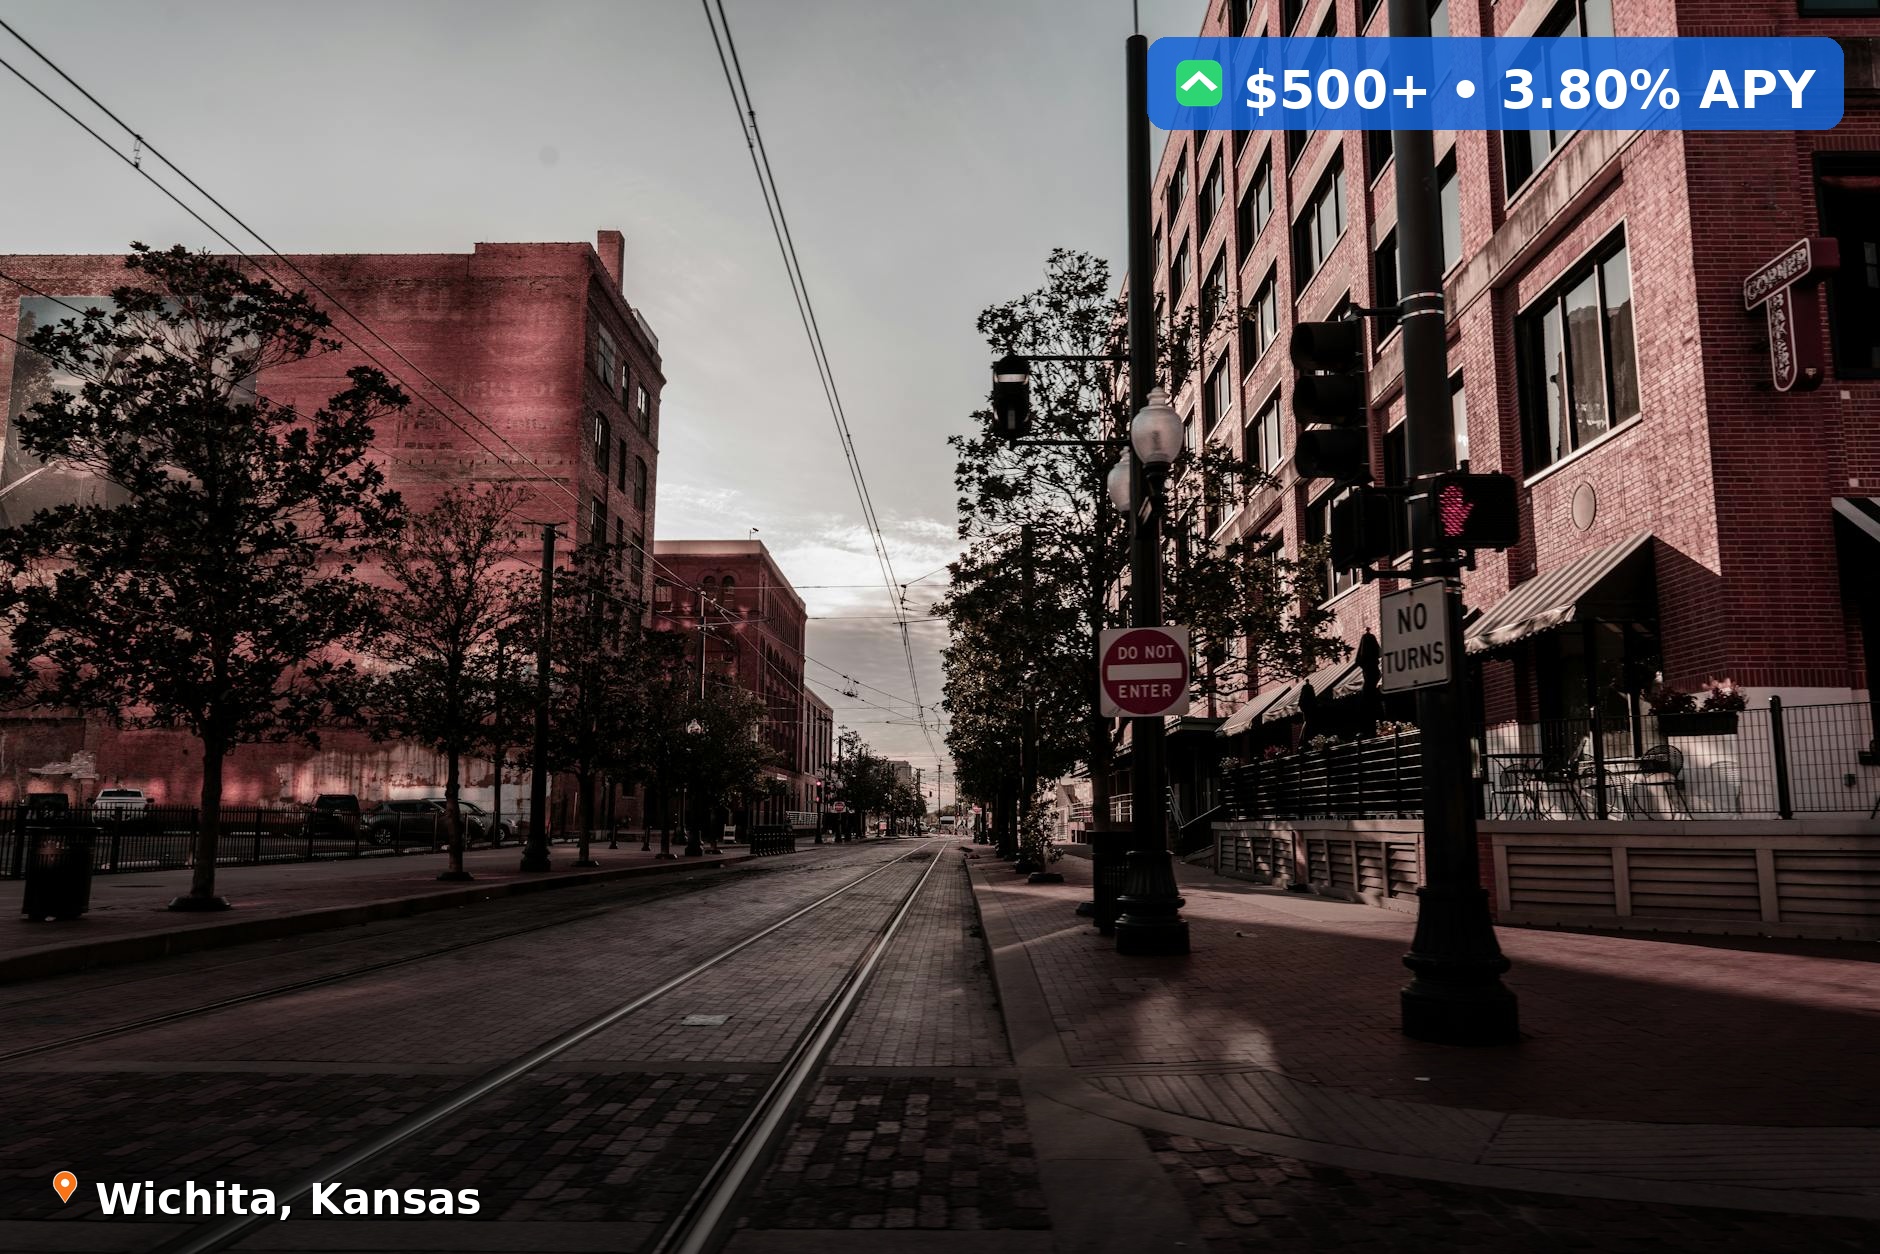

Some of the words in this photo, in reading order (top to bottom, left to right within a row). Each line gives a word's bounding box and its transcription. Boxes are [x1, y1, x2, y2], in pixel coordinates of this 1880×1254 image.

[1747, 248, 1807, 301] CORNER
[1771, 293, 1791, 382] BAKERY
[1398, 603, 1427, 635] NO
[1118, 646, 1138, 660] DO
[1145, 645, 1175, 659] NOT
[1384, 641, 1444, 674] TURNS
[1118, 684, 1172, 699] ENTER
